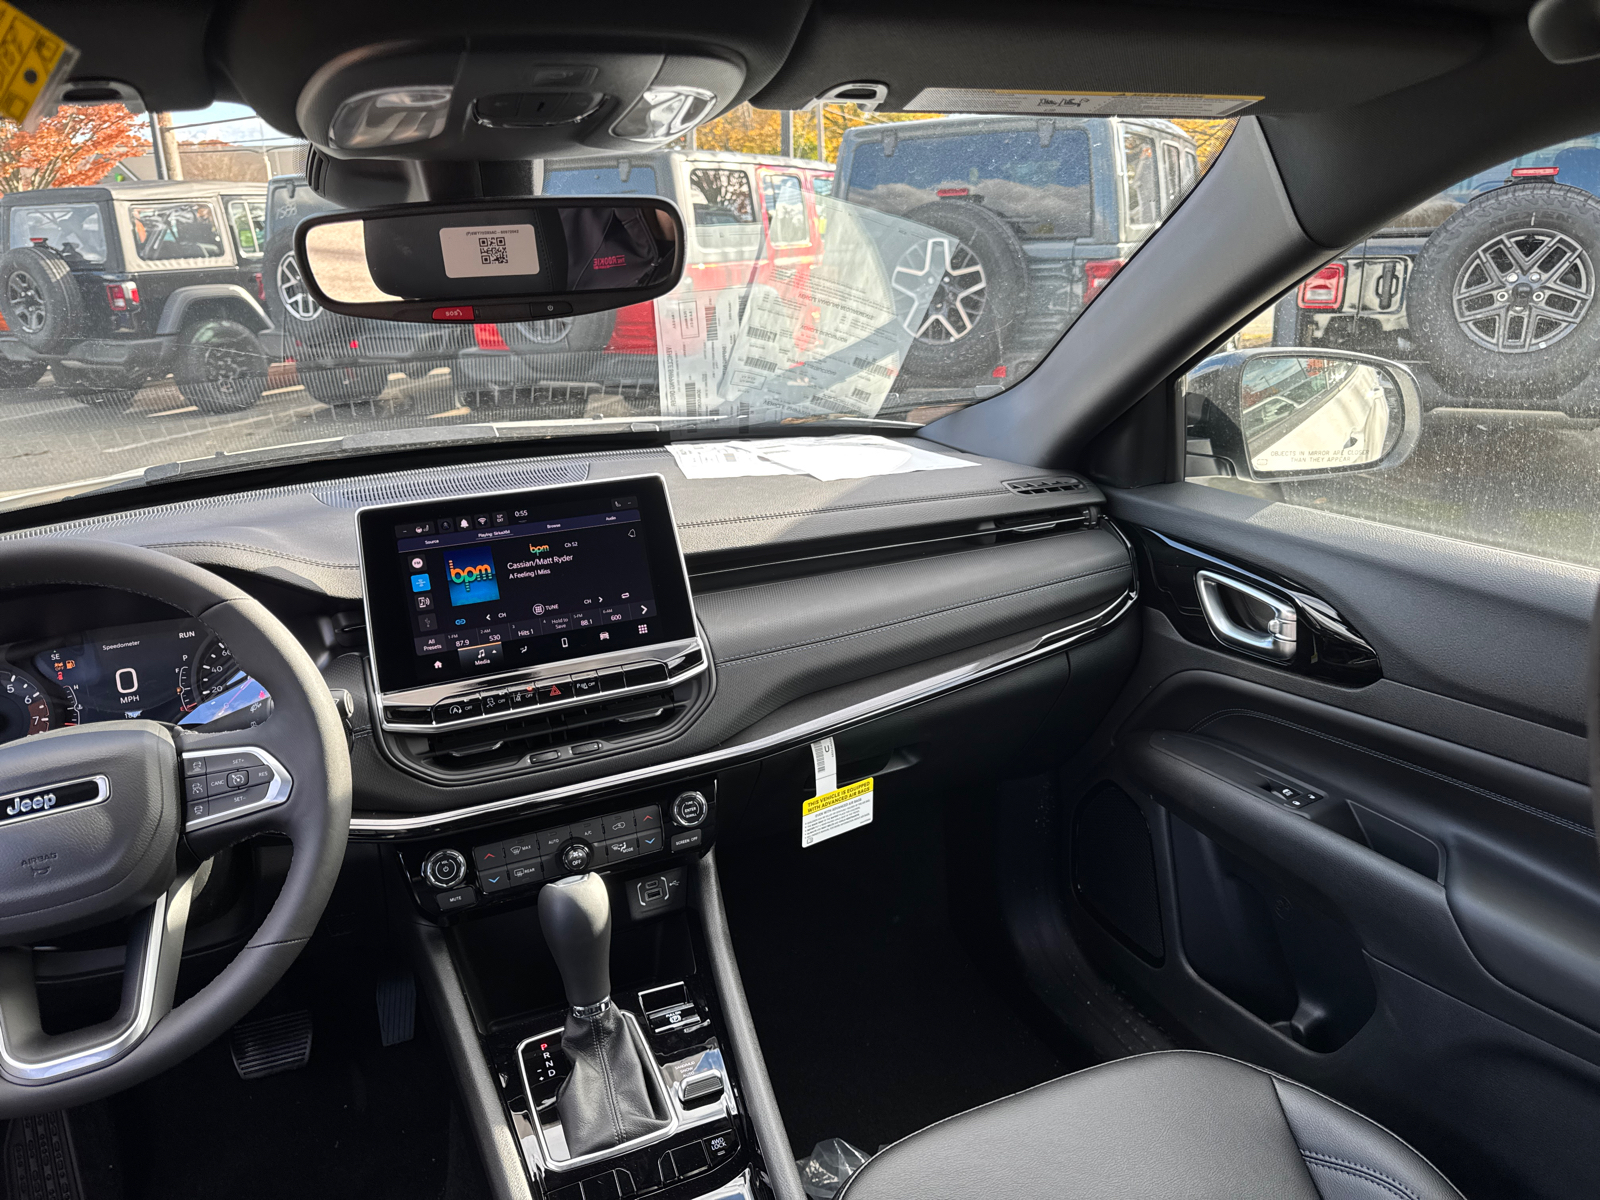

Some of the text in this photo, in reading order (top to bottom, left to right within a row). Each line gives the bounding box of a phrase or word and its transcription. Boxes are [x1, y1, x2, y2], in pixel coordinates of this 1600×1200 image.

[514, 509, 528, 518] 0:55
[529, 543, 550, 556] bpm
[507, 554, 574, 570] Cassian/Matt Ryder
[448, 560, 493, 593] bpm
[514, 570, 535, 579] Feeling
[545, 603, 559, 611] TUNE
[580, 619, 593, 627] 88.1
[178, 630, 195, 639] RUN
[489, 634, 501, 642] 530
[102, 640, 141, 651] Speedometer
[423, 643, 442, 652] Presets
[455, 639, 470, 647] 87.9
[50, 653, 61, 661] SE
[474, 658, 491, 666] Media
[211, 665, 223, 673] 40
[115, 667, 139, 694] 0
[6, 684, 15, 694] 5
[24, 695, 32, 705] 6
[120, 694, 140, 704] MPH
[32, 715, 39, 725] 7
[824, 745, 830, 753] U
[211, 779, 225, 787] CANC
[807, 800, 820, 808] THIS
[819, 791, 841, 804] VEHICLE
[847, 781, 871, 794] EQUIPPED
[6, 793, 57, 816] Jeep
[807, 787, 870, 813] WITH ADVANCED AIR BAGS
[675, 838, 690, 846] SCREEN
[21, 852, 58, 867] AIRBAG
[449, 895, 462, 903] MUTE
[540, 1043, 548, 1051] P
[543, 1051, 551, 1059] R
[545, 1060, 554, 1068] N
[547, 1069, 556, 1077] D
[680, 1066, 694, 1074] SNOW
[711, 1136, 725, 1145] 4WD
[711, 1142, 727, 1151] LOCK
